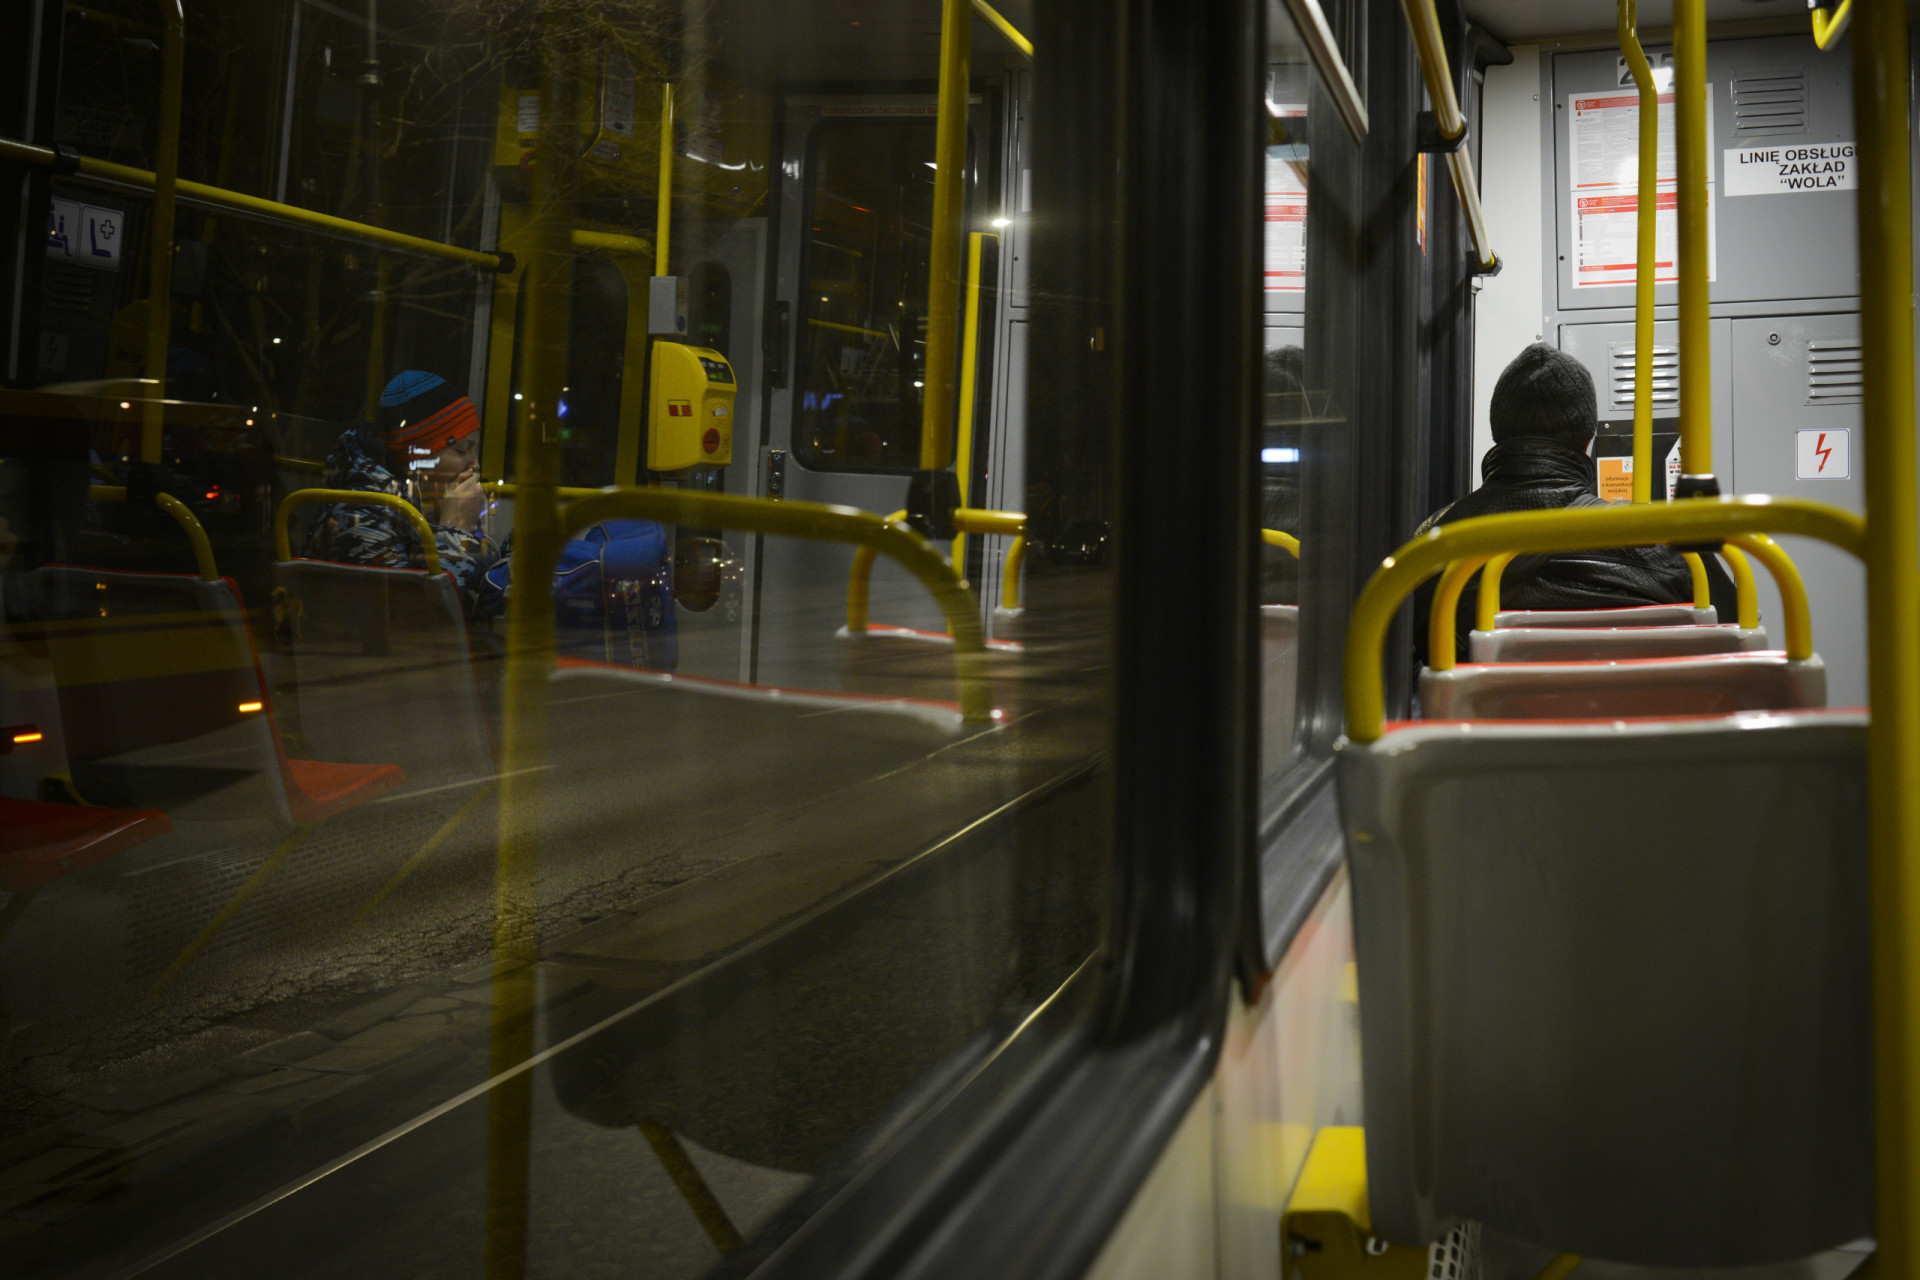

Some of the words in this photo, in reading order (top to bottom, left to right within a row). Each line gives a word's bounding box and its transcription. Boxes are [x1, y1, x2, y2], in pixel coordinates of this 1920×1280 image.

[1740, 150, 1780, 165] LINIĘ
[1785, 145, 1857, 161] OBSŁUG
[1779, 161, 1845, 176] ZAKŁAD
